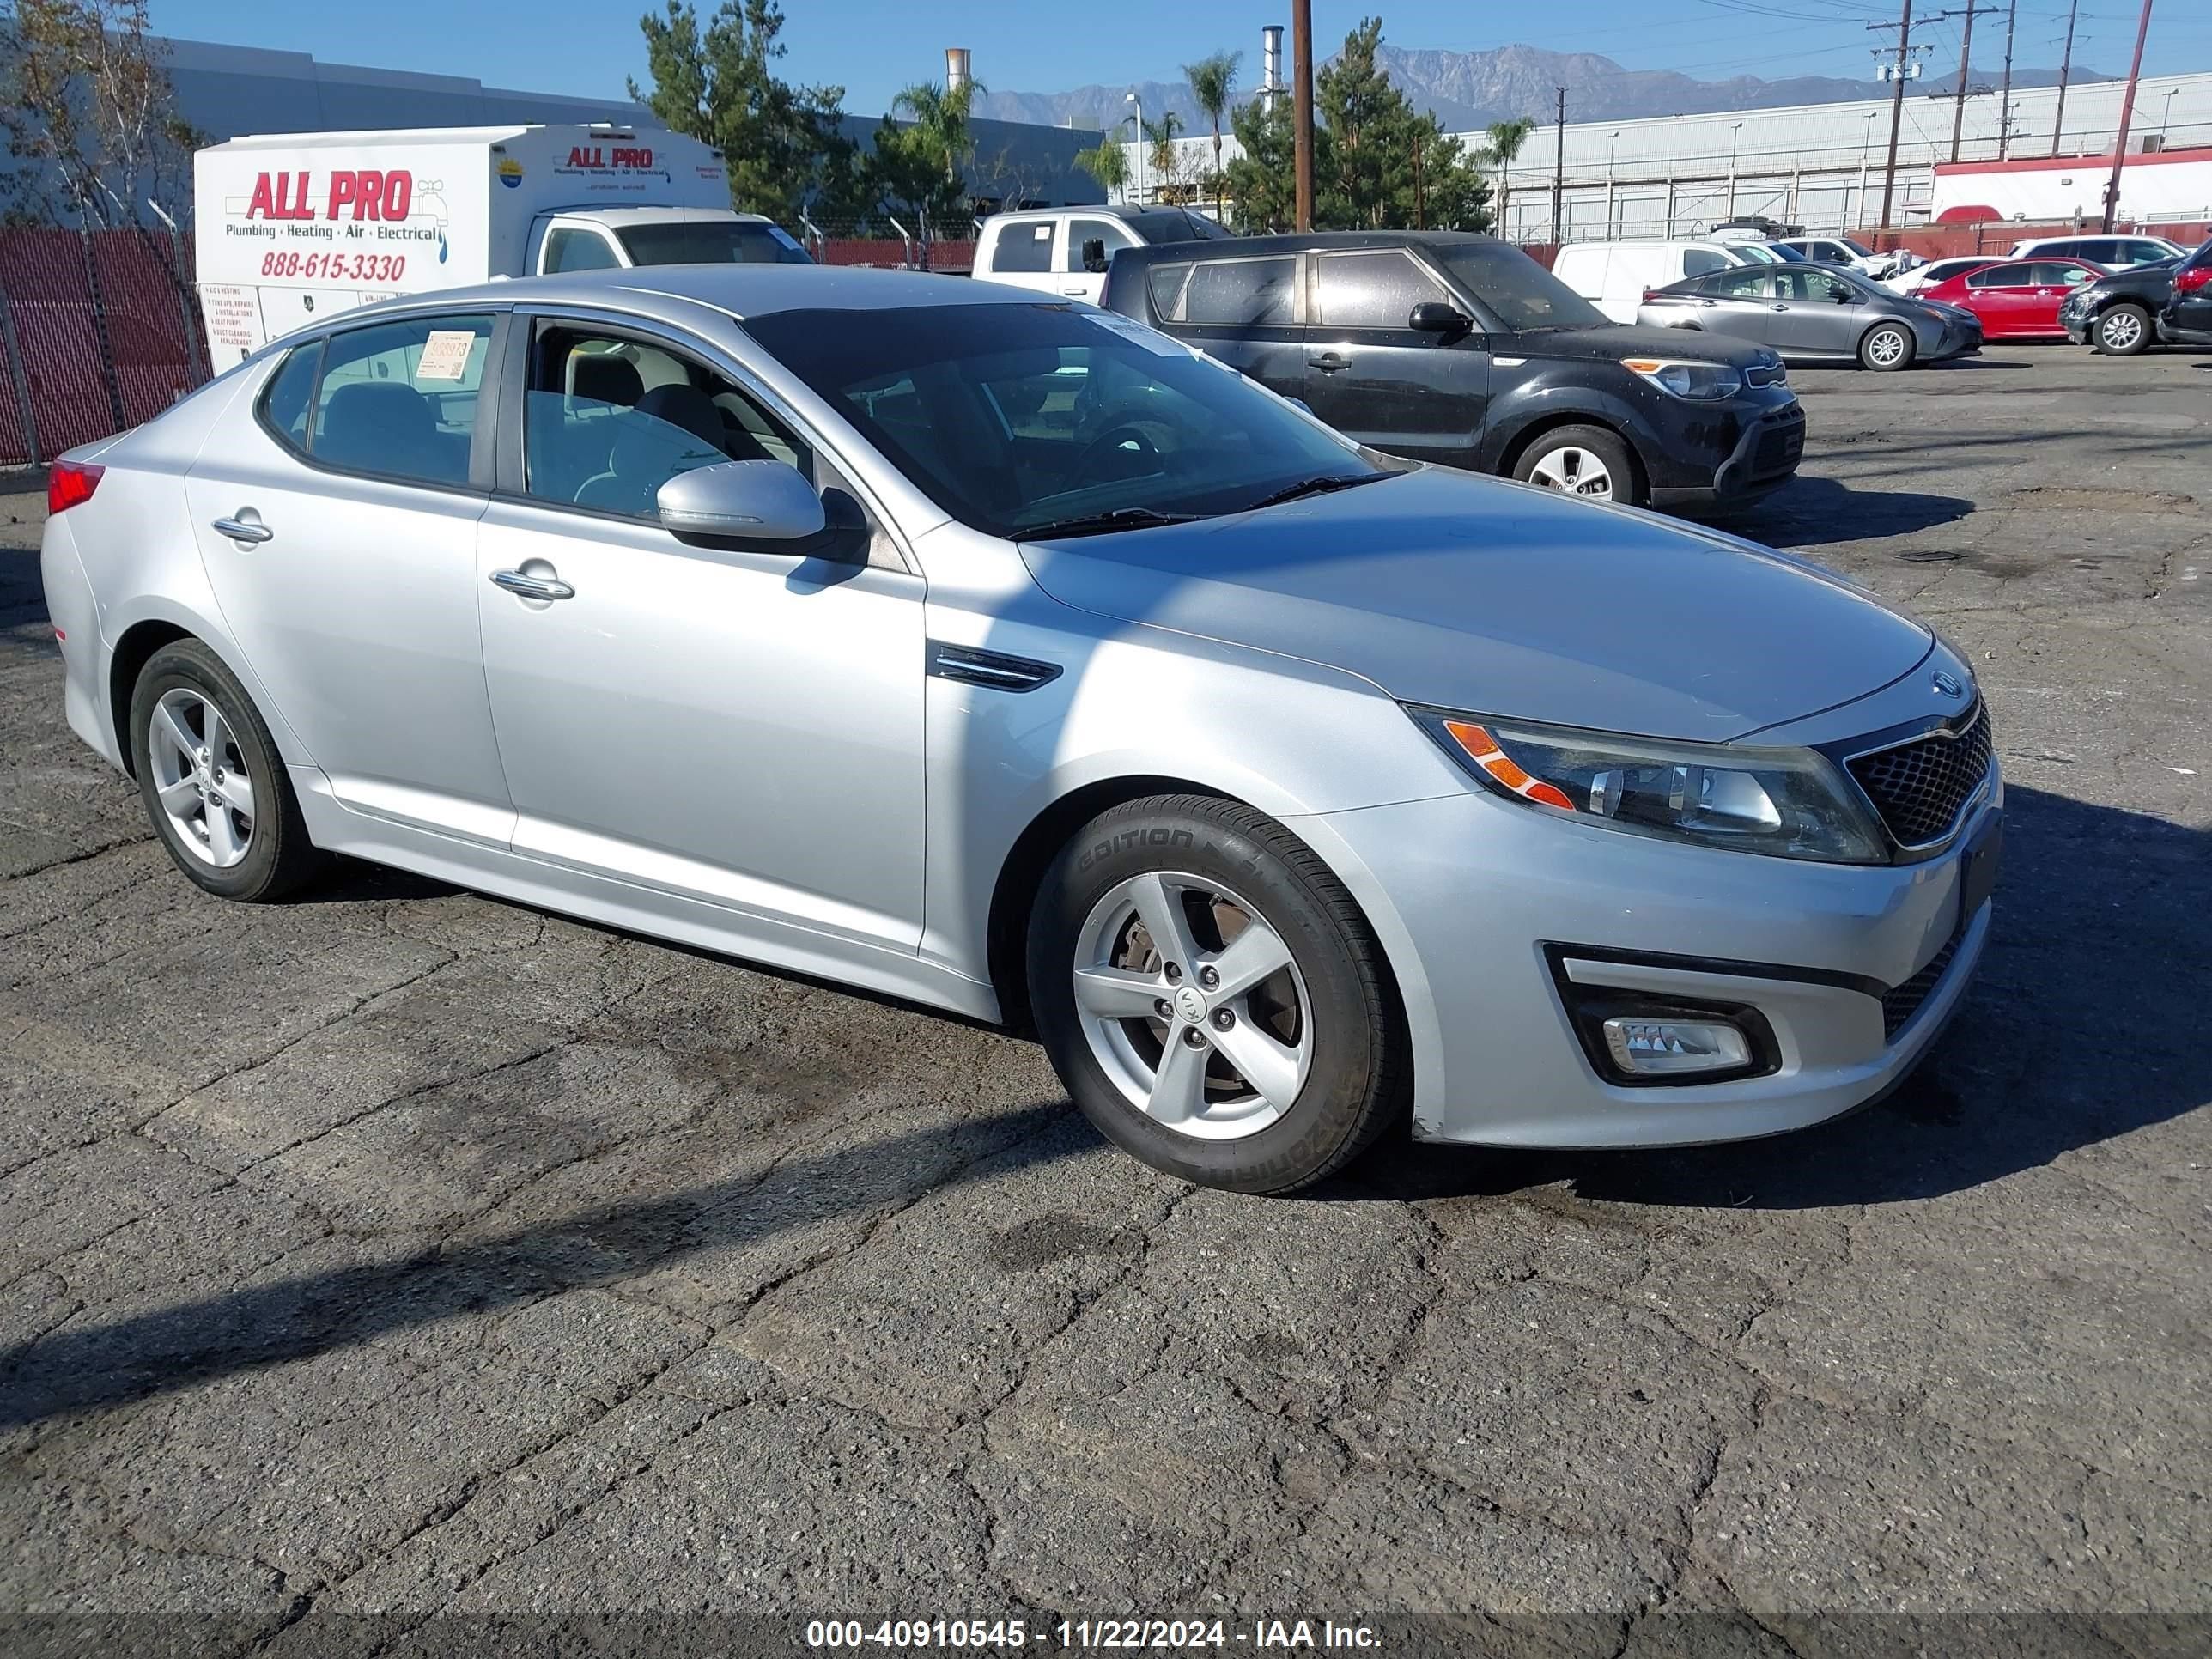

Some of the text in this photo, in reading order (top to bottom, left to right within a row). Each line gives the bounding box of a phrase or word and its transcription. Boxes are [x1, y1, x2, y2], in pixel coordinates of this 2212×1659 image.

[567, 146, 653, 168] ALL PRO
[246, 170, 413, 222] ALL PRO
[226, 224, 437, 240] Plumbing Heating Air Electrical
[261, 252, 406, 282] 888-615-3330
[221, 287, 241, 295] HEATING
[234, 300, 254, 308] REPAIRS
[226, 319, 241, 327] PUMPS
[220, 337, 252, 346] REPLACEMENT
[1078, 828, 1194, 873] EDITION
[1182, 990, 1200, 1020] KIA
